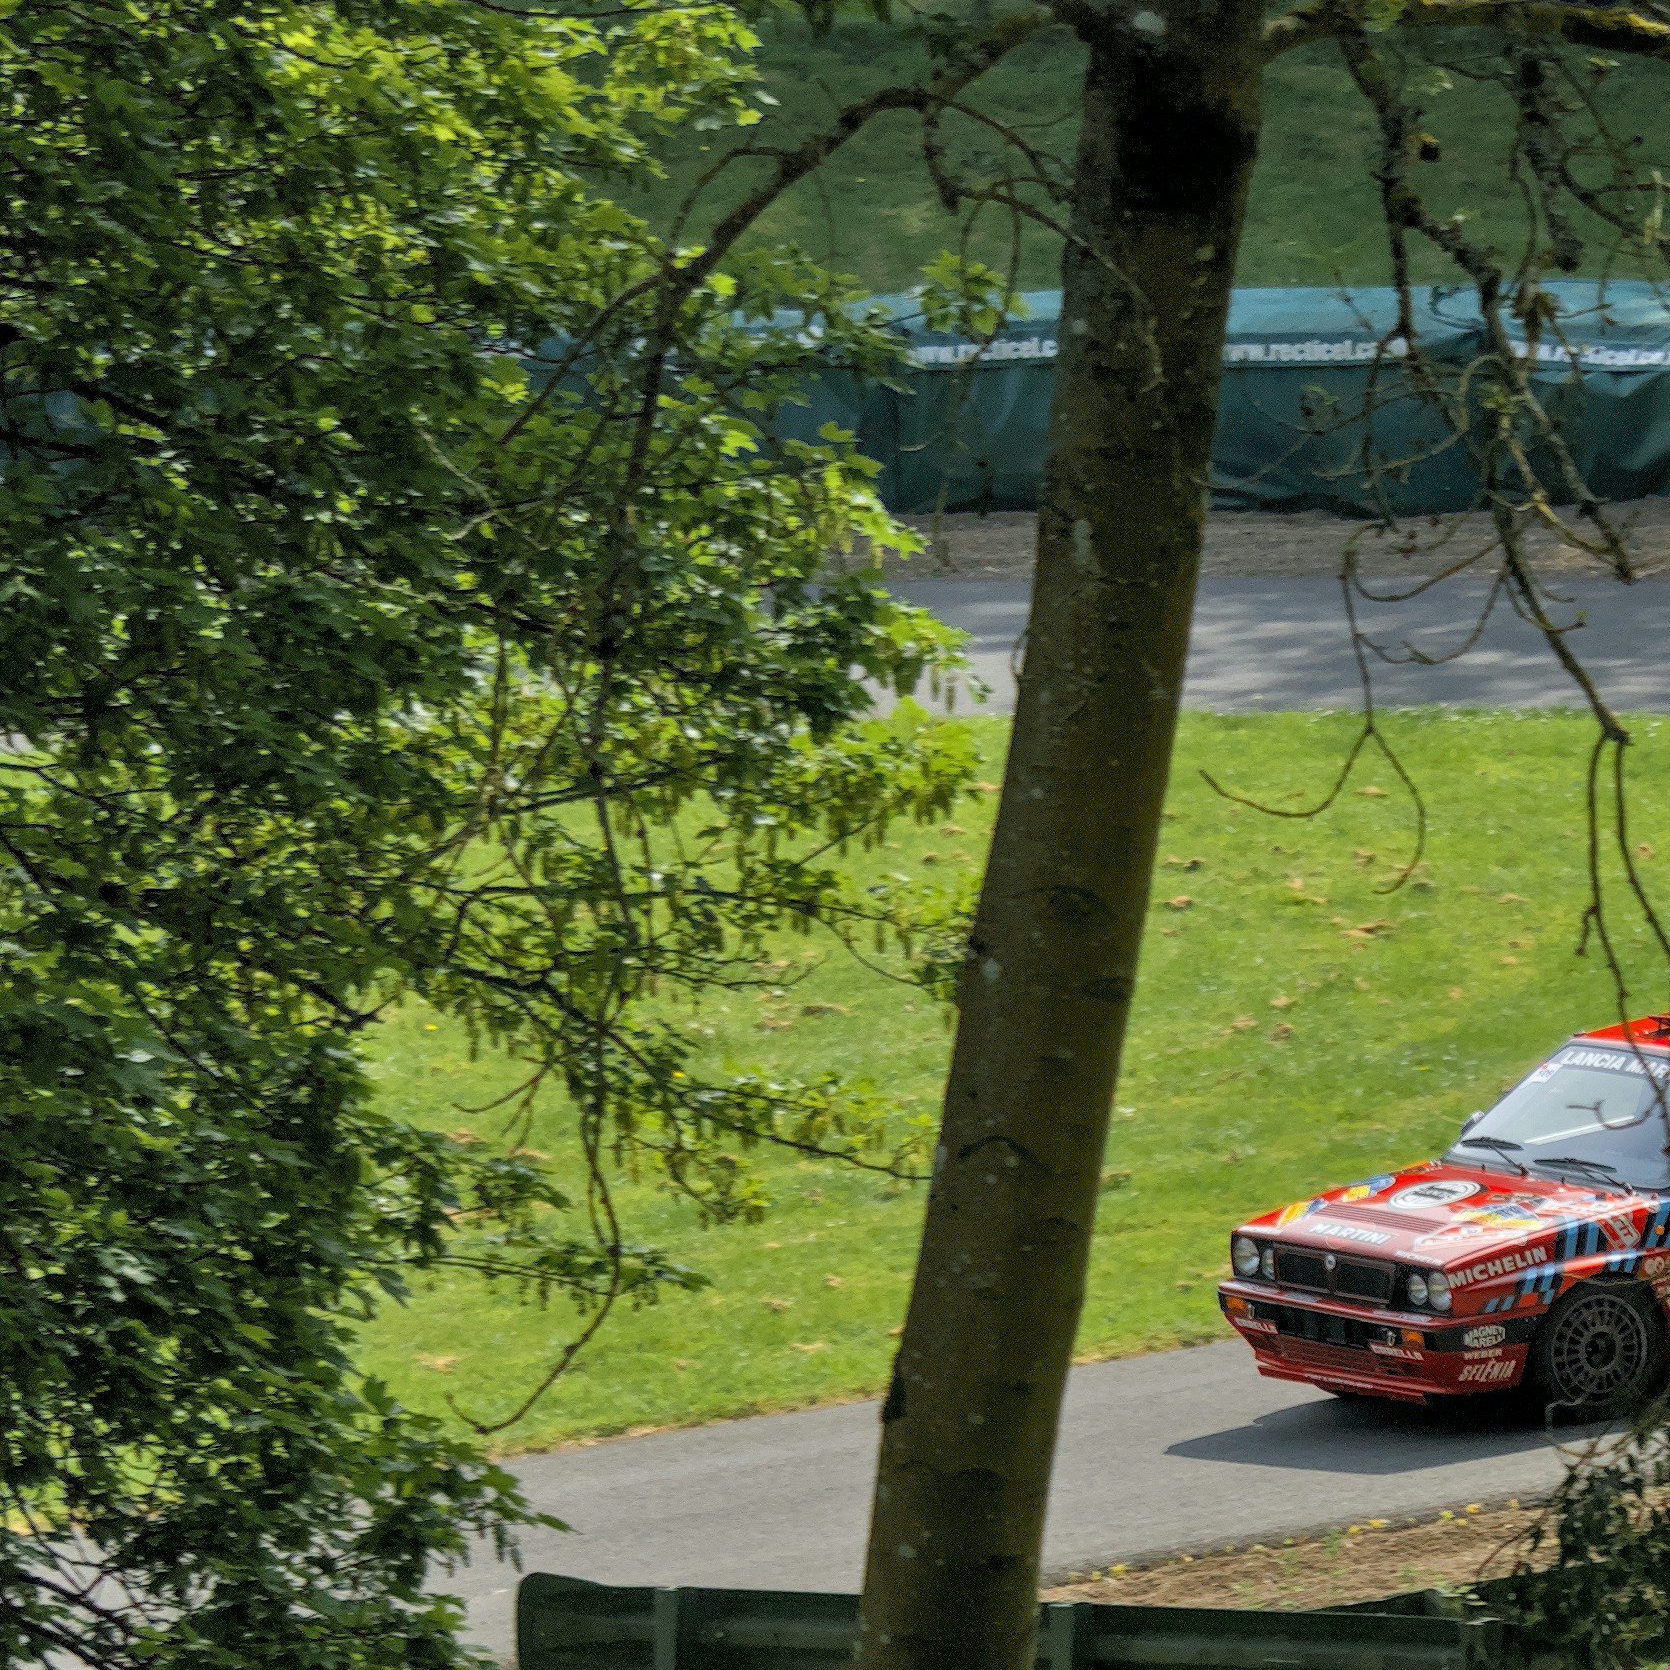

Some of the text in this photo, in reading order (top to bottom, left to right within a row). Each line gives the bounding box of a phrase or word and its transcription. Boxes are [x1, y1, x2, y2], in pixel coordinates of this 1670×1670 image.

[1561, 1050, 1627, 1072] LANCIA
[1310, 1222, 1392, 1246] MARTINI
[1448, 1246, 1548, 1290] MICHELIN
[1463, 1348, 1503, 1361] WEBER
